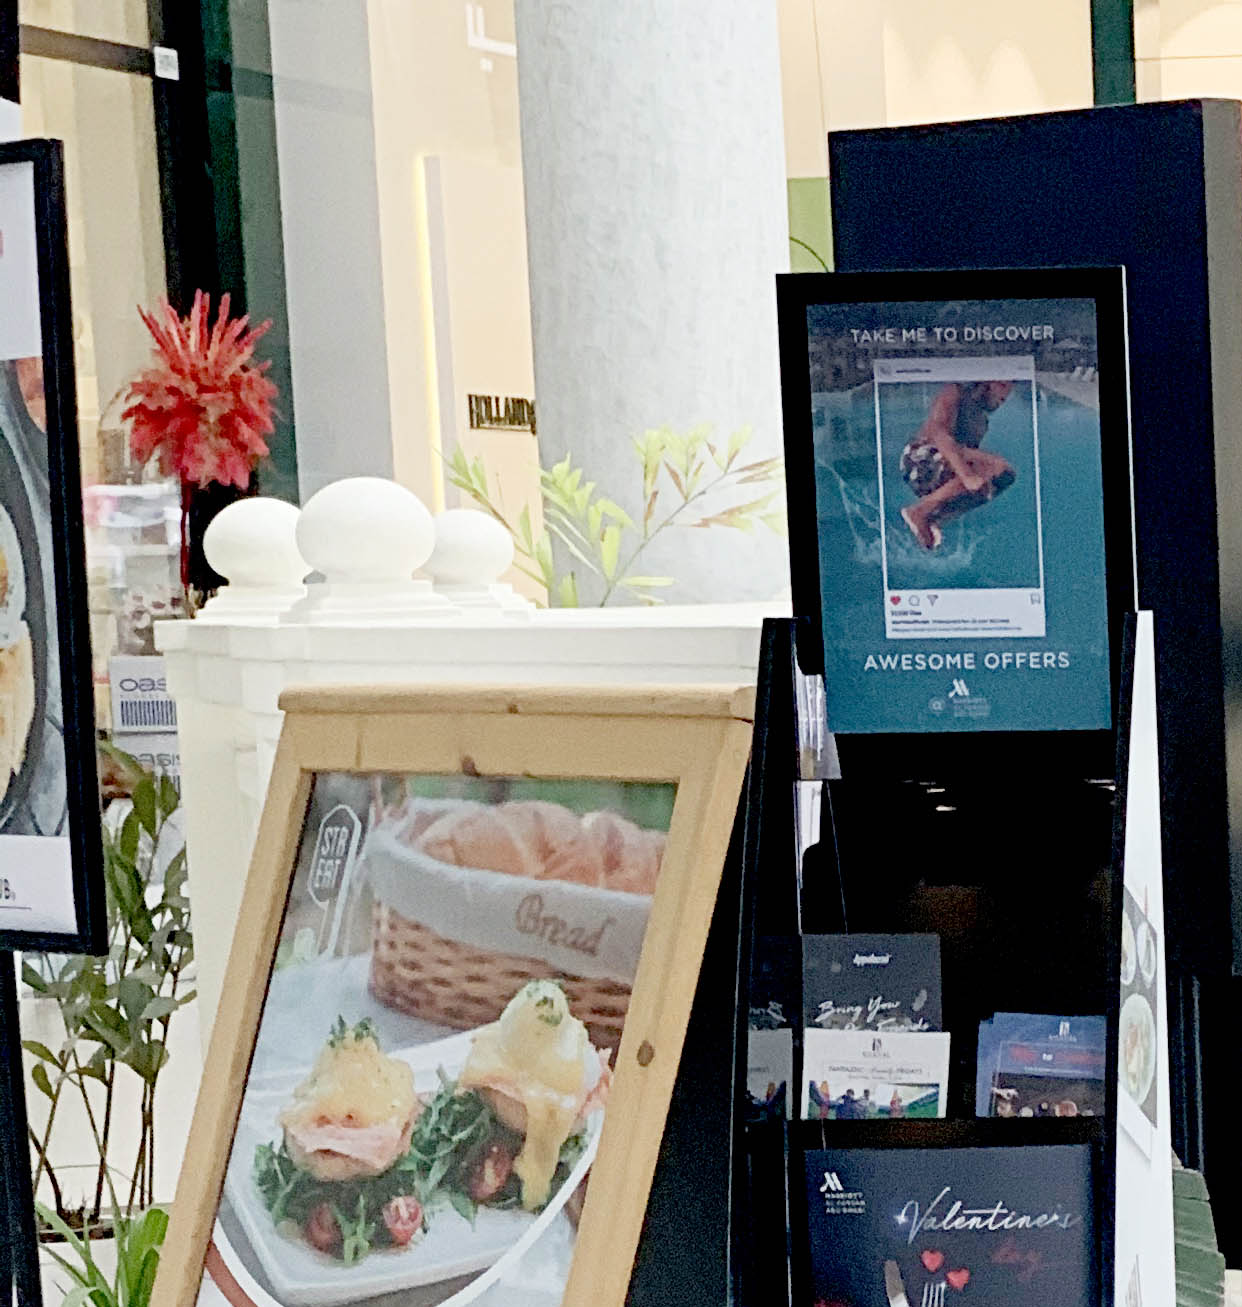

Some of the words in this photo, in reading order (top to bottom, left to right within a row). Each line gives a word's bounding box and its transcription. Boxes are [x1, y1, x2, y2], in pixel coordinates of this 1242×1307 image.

[850, 328, 896, 344] TAKE
[902, 327, 927, 342] ME
[934, 327, 957, 342] TO
[964, 325, 1055, 342] DISCOVER
[864, 653, 976, 671] AWESOME
[984, 651, 1071, 670] OFFERS
[515, 893, 617, 956] Bread
[815, 1000, 863, 1024] Bring
